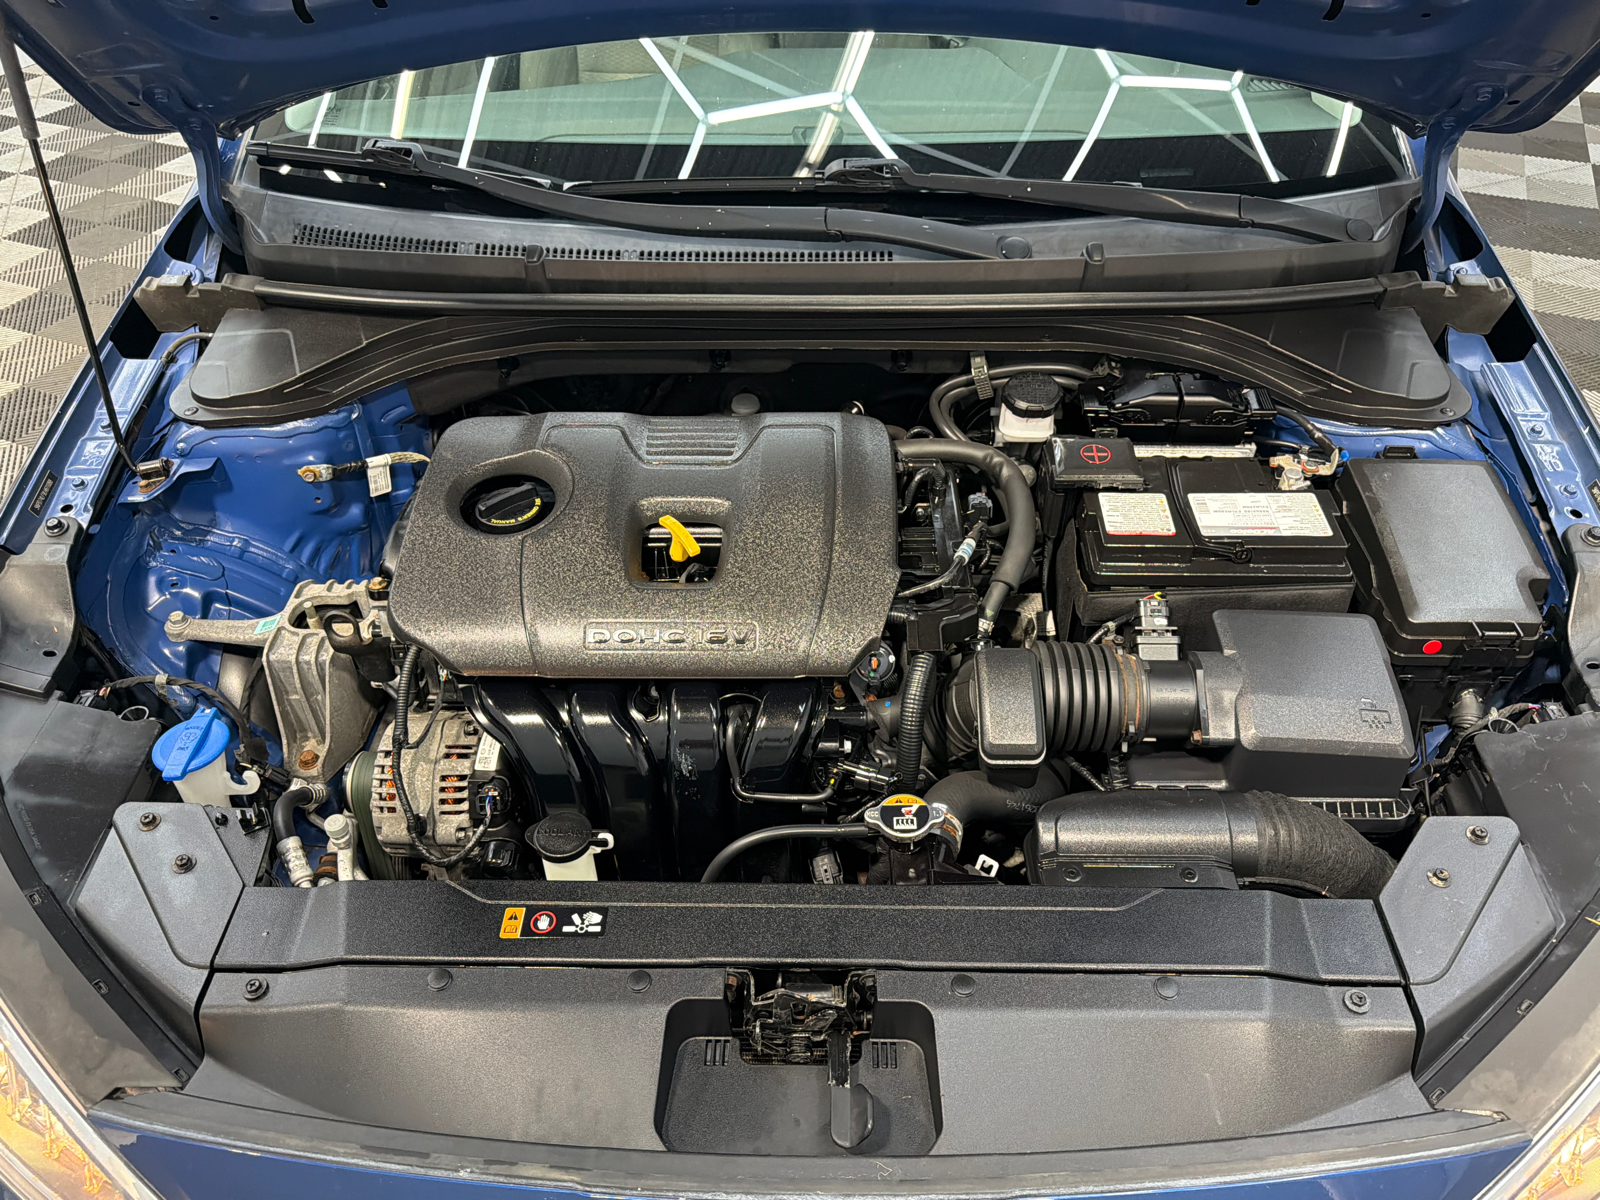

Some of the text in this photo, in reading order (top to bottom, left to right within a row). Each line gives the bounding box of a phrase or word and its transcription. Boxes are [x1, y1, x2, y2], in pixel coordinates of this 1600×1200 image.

[587, 628, 753, 645] DOHC 16V
[537, 827, 590, 838] COOLANT
